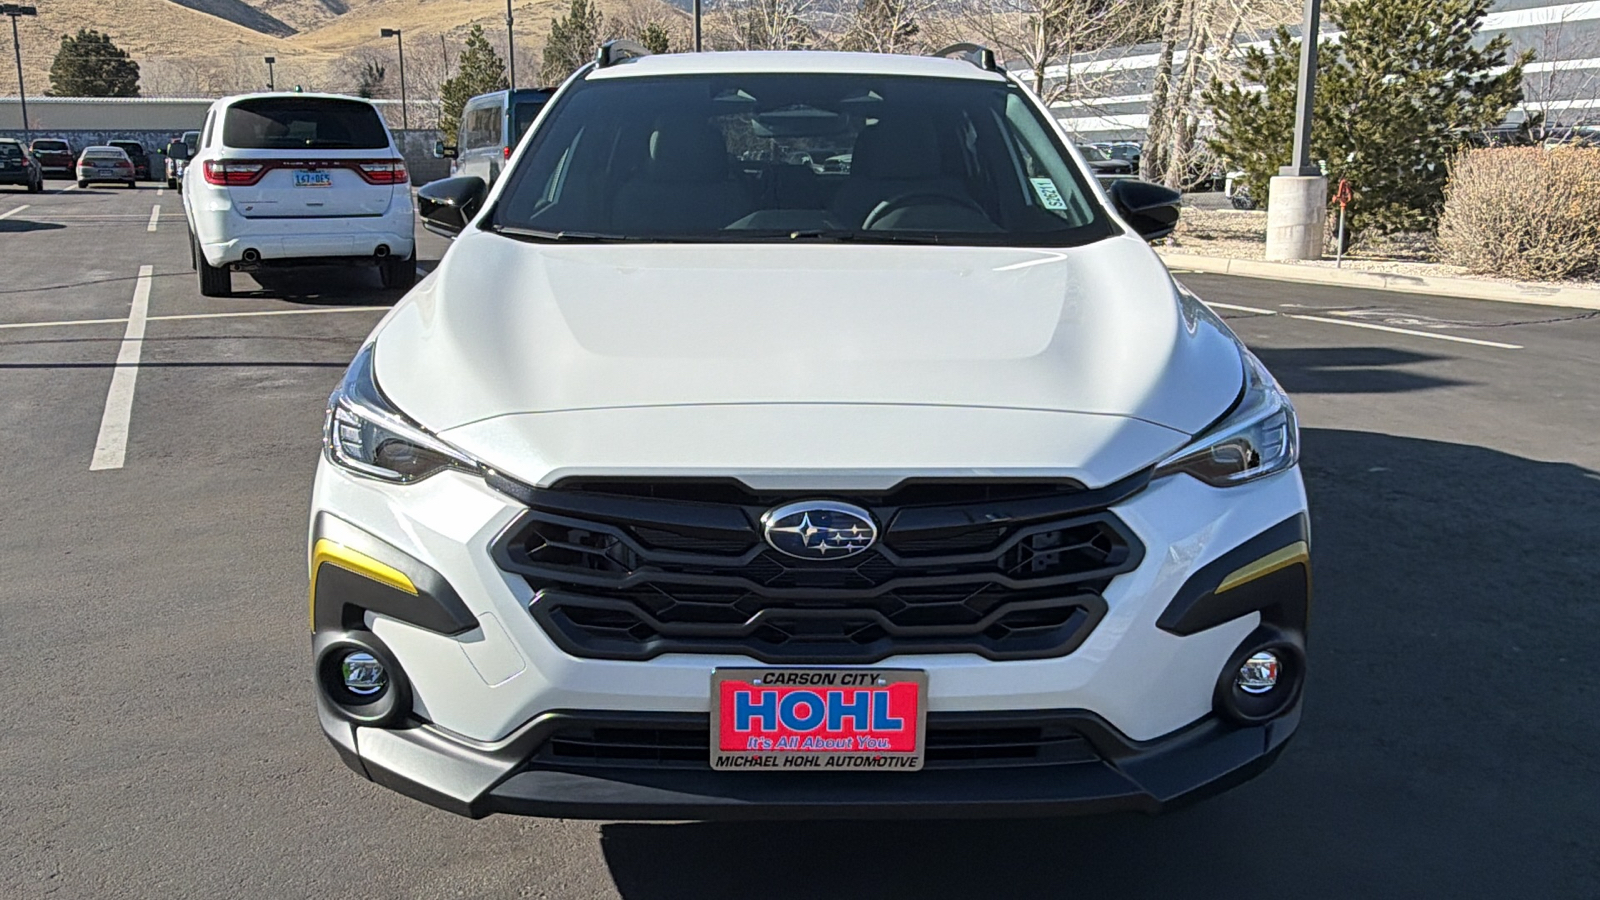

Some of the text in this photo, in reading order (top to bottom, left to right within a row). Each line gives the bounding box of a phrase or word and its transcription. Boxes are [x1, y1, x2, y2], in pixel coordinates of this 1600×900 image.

[762, 672, 880, 685] CARSON CITY
[734, 690, 904, 732] HOHL
[747, 736, 891, 749] It's All About You.
[715, 756, 918, 768] MICHAEL HOHL AUTOMOTIVE
